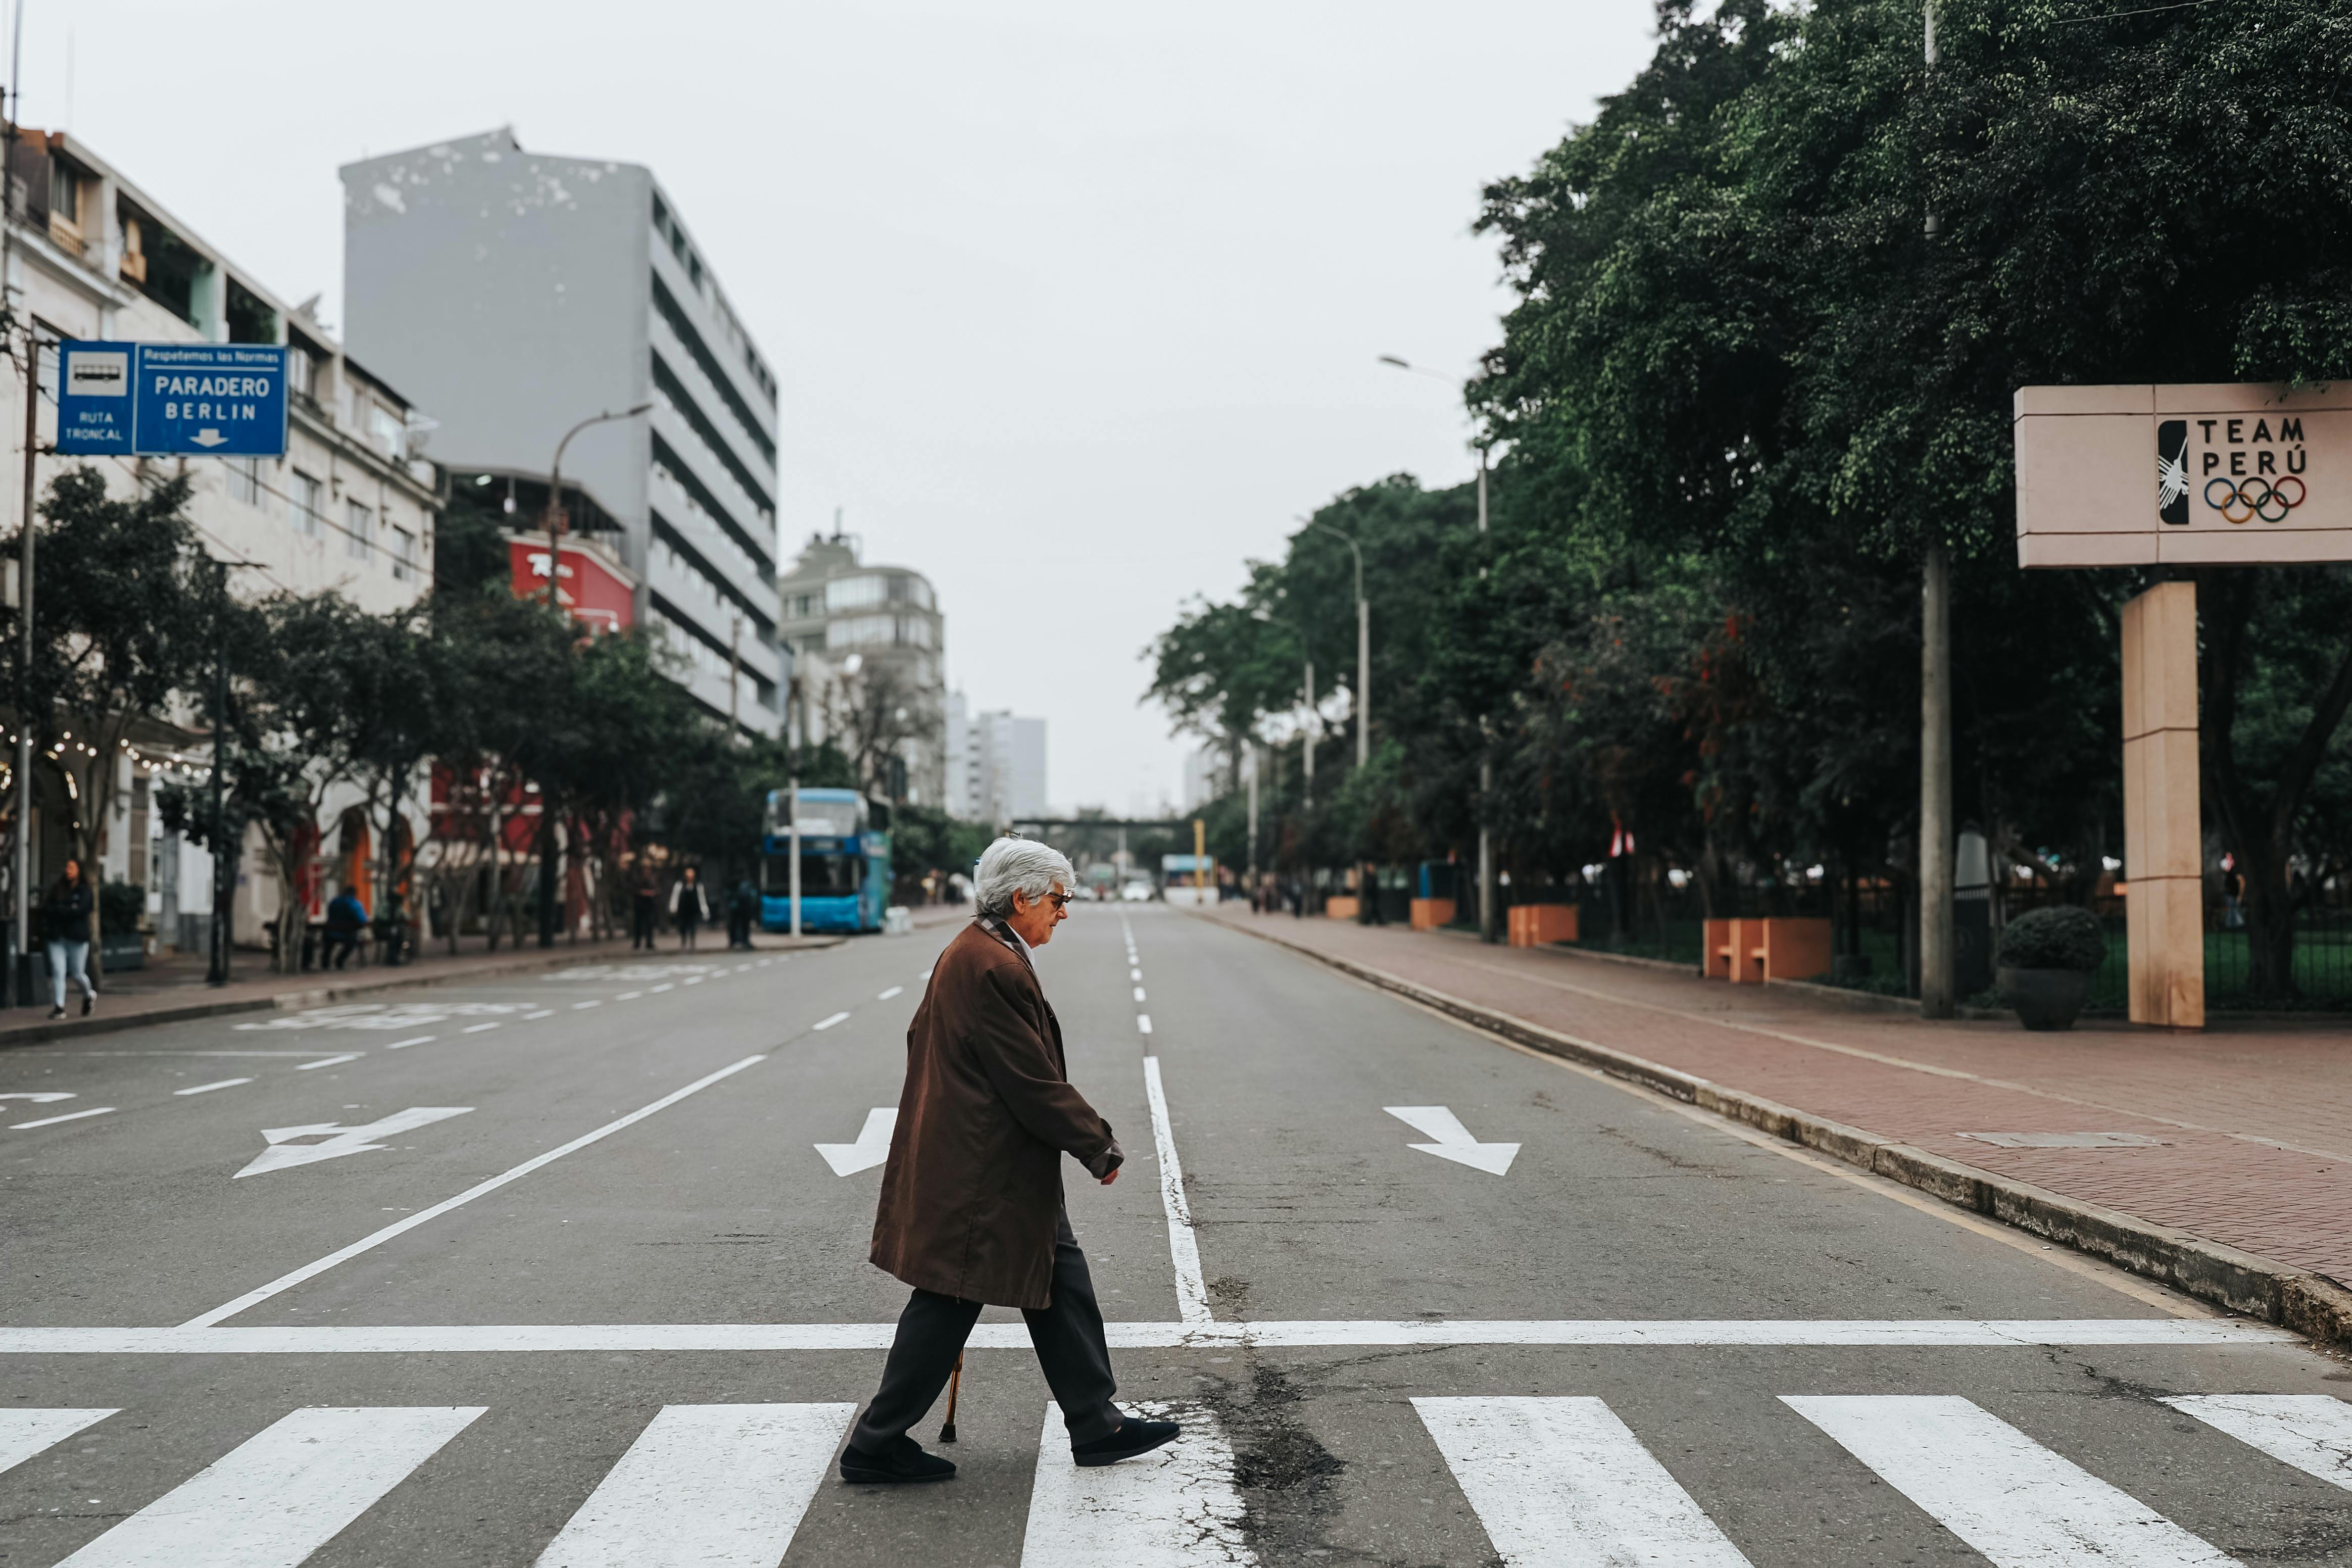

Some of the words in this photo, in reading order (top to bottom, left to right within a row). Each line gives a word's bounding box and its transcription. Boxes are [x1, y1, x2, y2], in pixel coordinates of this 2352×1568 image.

[144, 348, 214, 362] Respetemos
[217, 351, 233, 362] las
[235, 351, 279, 363] Normas
[155, 376, 270, 397] PARADERO
[79, 412, 114, 424] RUTA
[165, 402, 256, 420] BERLIN
[66, 428, 123, 441] TRONCAL
[2197, 418, 2305, 444] TEAM
[2202, 444, 2307, 476] PERÚ
